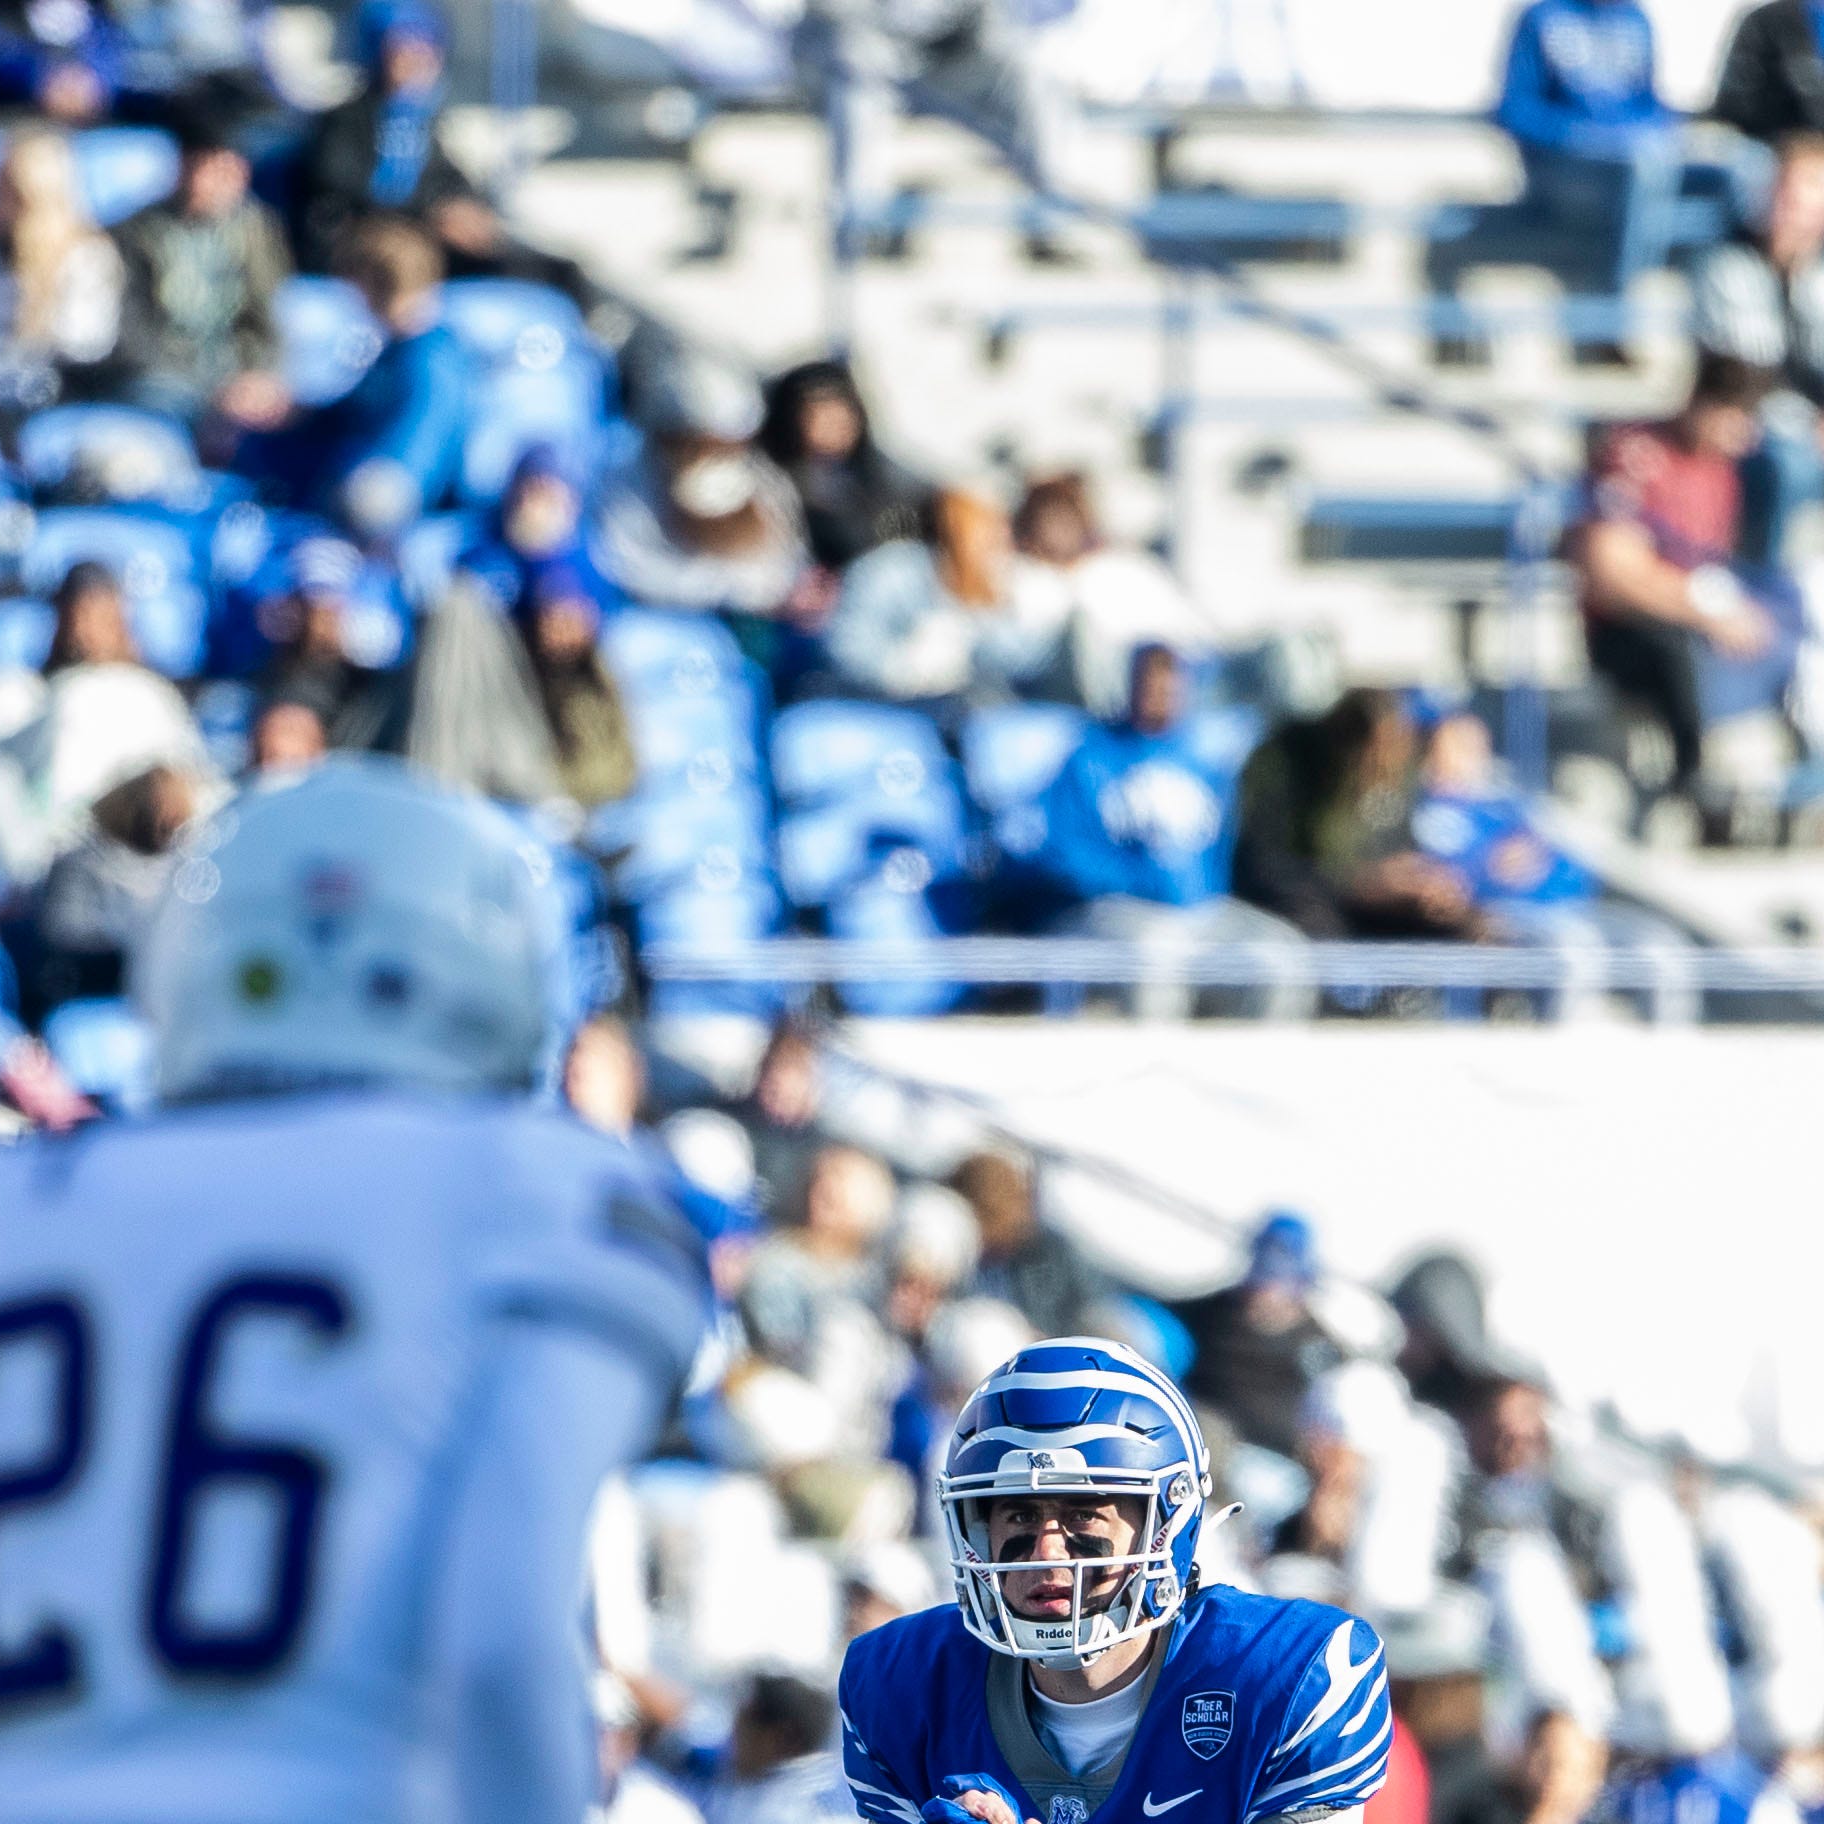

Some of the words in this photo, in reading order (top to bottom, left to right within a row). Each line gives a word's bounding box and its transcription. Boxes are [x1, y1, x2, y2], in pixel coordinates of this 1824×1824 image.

[1036, 1629, 1081, 1639] Riddel
[1194, 1699, 1223, 1712] TIGER
[1185, 1711, 1229, 1723] SCHOLAR
